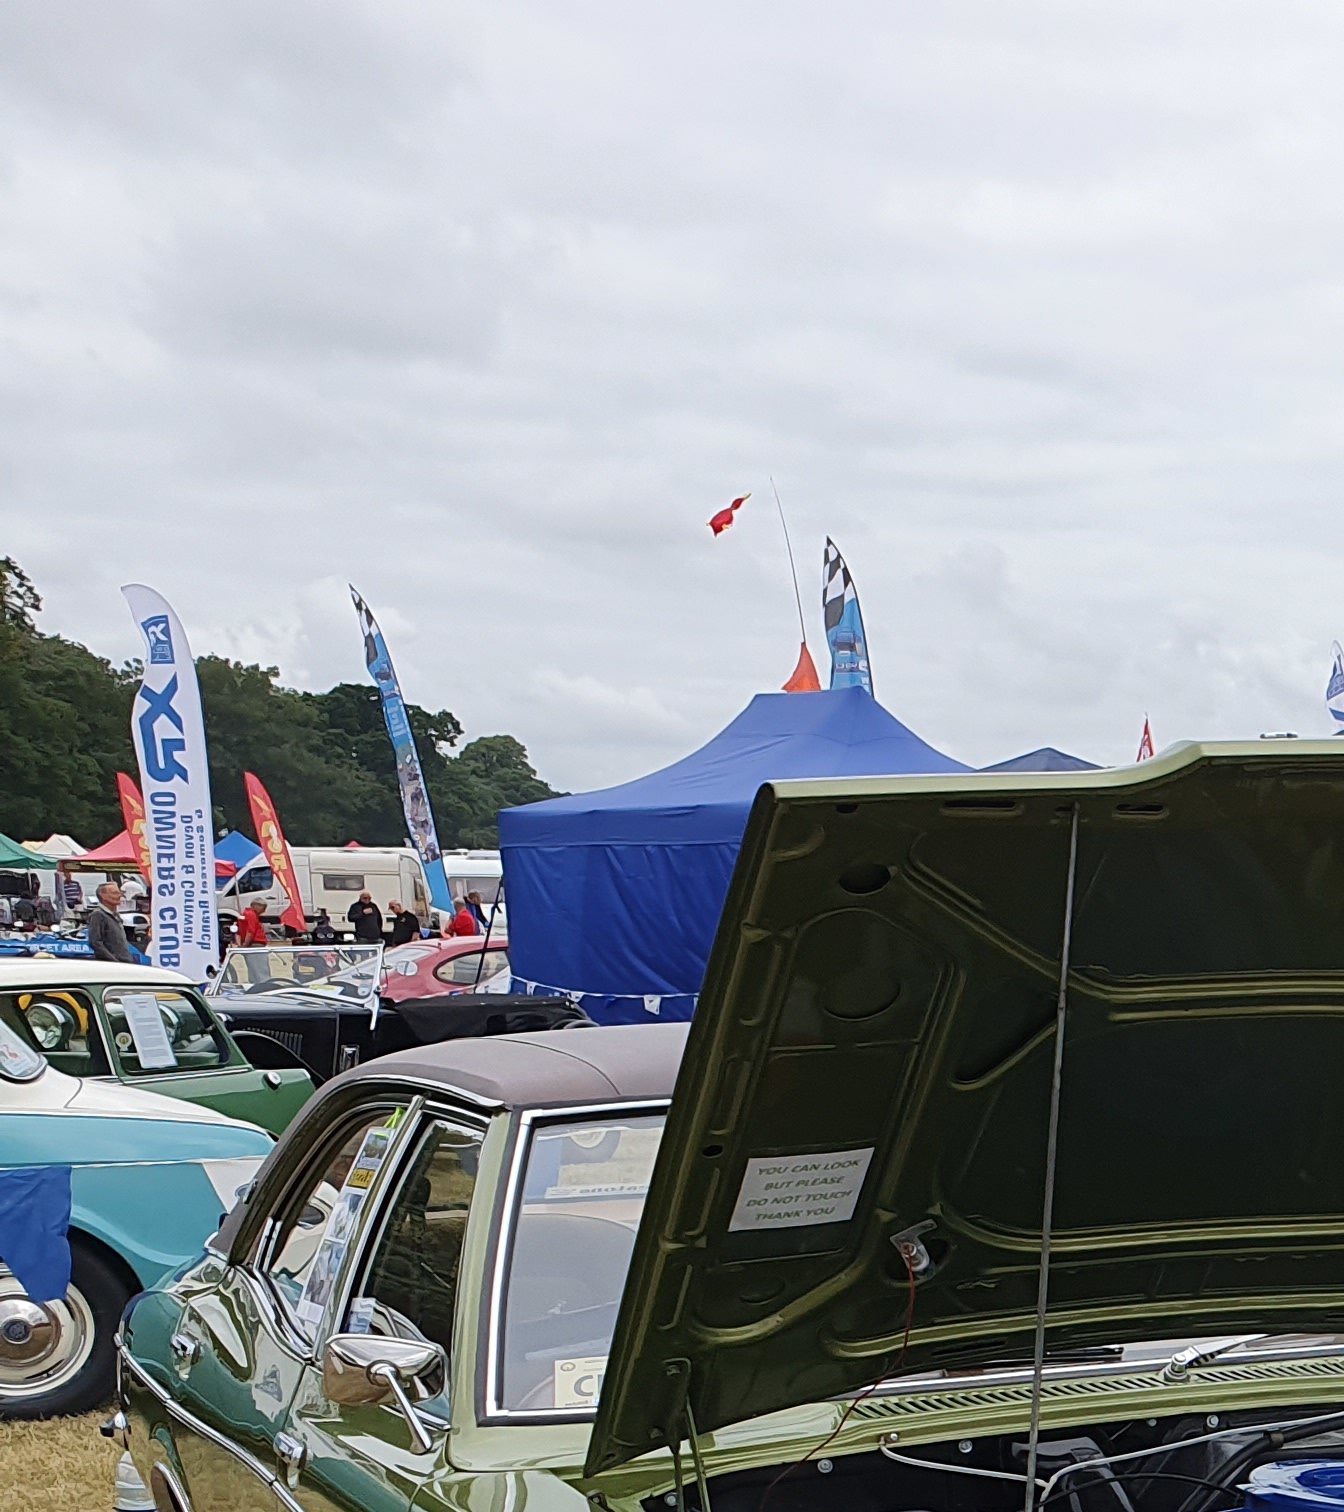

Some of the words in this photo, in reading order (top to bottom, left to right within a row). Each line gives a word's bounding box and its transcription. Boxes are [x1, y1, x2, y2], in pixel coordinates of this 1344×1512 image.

[758, 1166, 789, 1176] YOU
[791, 1163, 822, 1173] CAN
[824, 1160, 862, 1171] LOOK
[764, 1180, 794, 1191] BUT
[795, 1176, 844, 1187] PLEASE
[746, 1197, 768, 1207] DO
[771, 1194, 802, 1205] NOT
[805, 1190, 852, 1201] TOUCH
[755, 1210, 803, 1221] THANK
[806, 1206, 836, 1217] YOU
